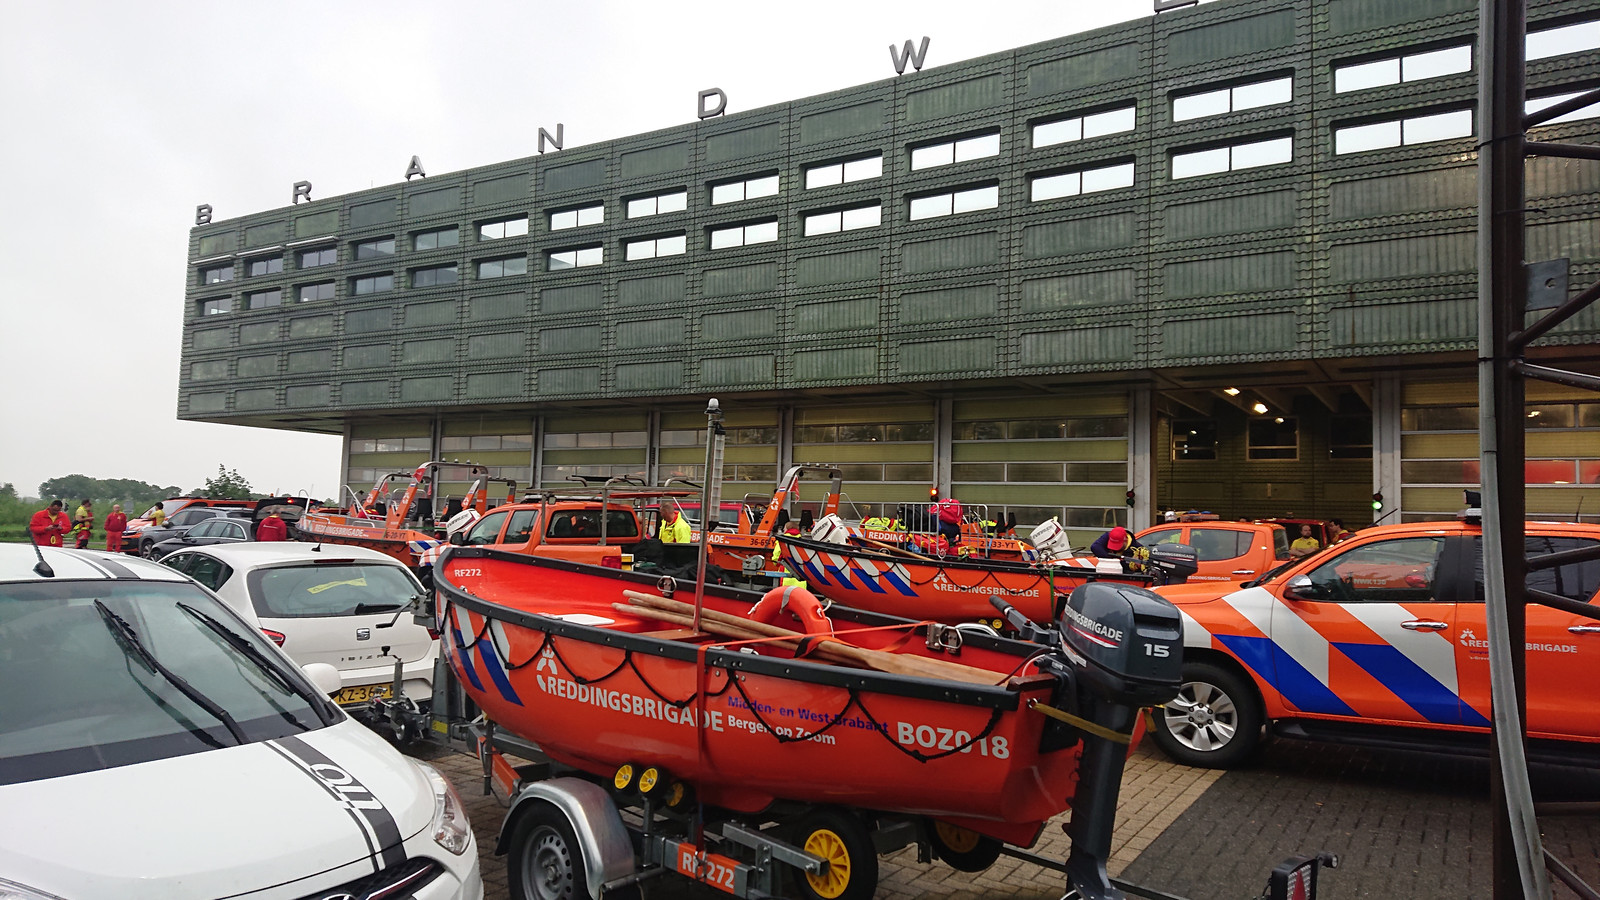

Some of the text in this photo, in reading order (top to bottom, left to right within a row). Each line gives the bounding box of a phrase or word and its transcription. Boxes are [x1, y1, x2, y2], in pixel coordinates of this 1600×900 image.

[293, 180, 312, 204] R
[405, 155, 426, 180] A
[538, 123, 563, 153] N
[698, 87, 728, 119] D
[889, 36, 930, 75] W
[454, 568, 482, 578] RF272
[940, 583, 1040, 598] REDDINGSBRIGADE
[1064, 604, 1123, 641] EDDINGSBRIGADE
[1143, 643, 1170, 658] 15
[547, 675, 724, 733] REDDINGSBRIGADE
[727, 696, 889, 734] Midden- en West-Brabant
[775, 726, 793, 740] op
